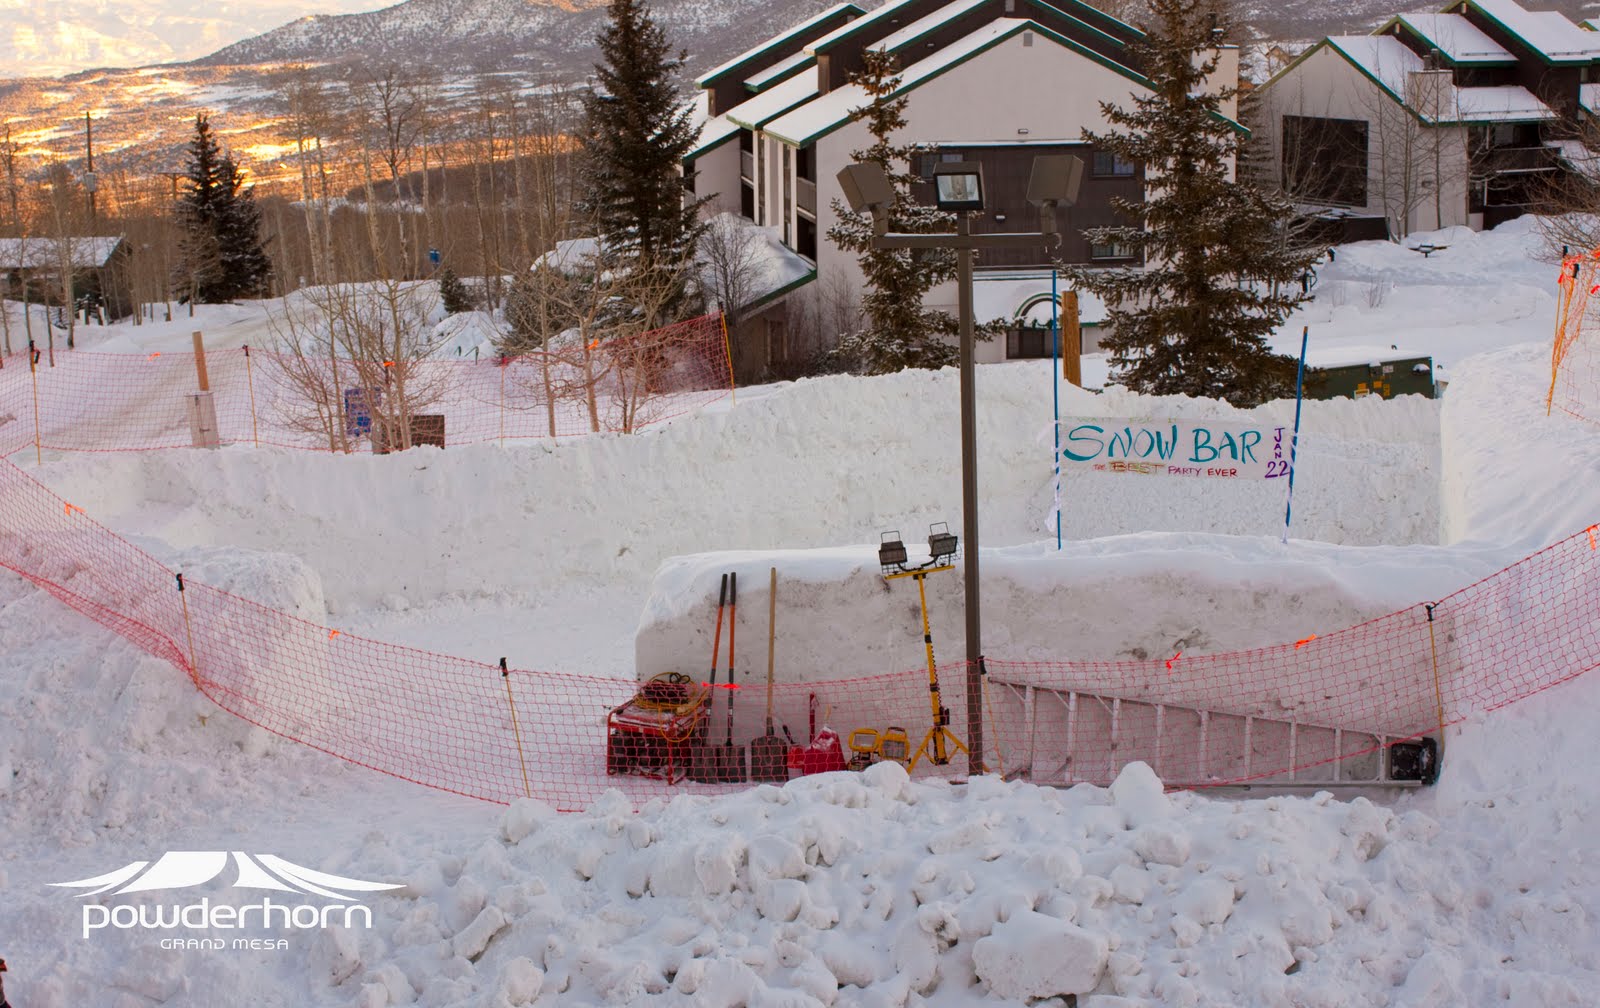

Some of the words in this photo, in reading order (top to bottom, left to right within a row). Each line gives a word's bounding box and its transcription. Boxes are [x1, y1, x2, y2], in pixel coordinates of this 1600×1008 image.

[1063, 425, 1178, 461] SNOW
[1189, 428, 1262, 464] BAR
[1274, 427, 1286, 459] JAN
[1108, 461, 1165, 474] BEST
[1168, 465, 1201, 476] PARTY
[1207, 468, 1238, 477] EVER
[1264, 460, 1290, 479] 22
